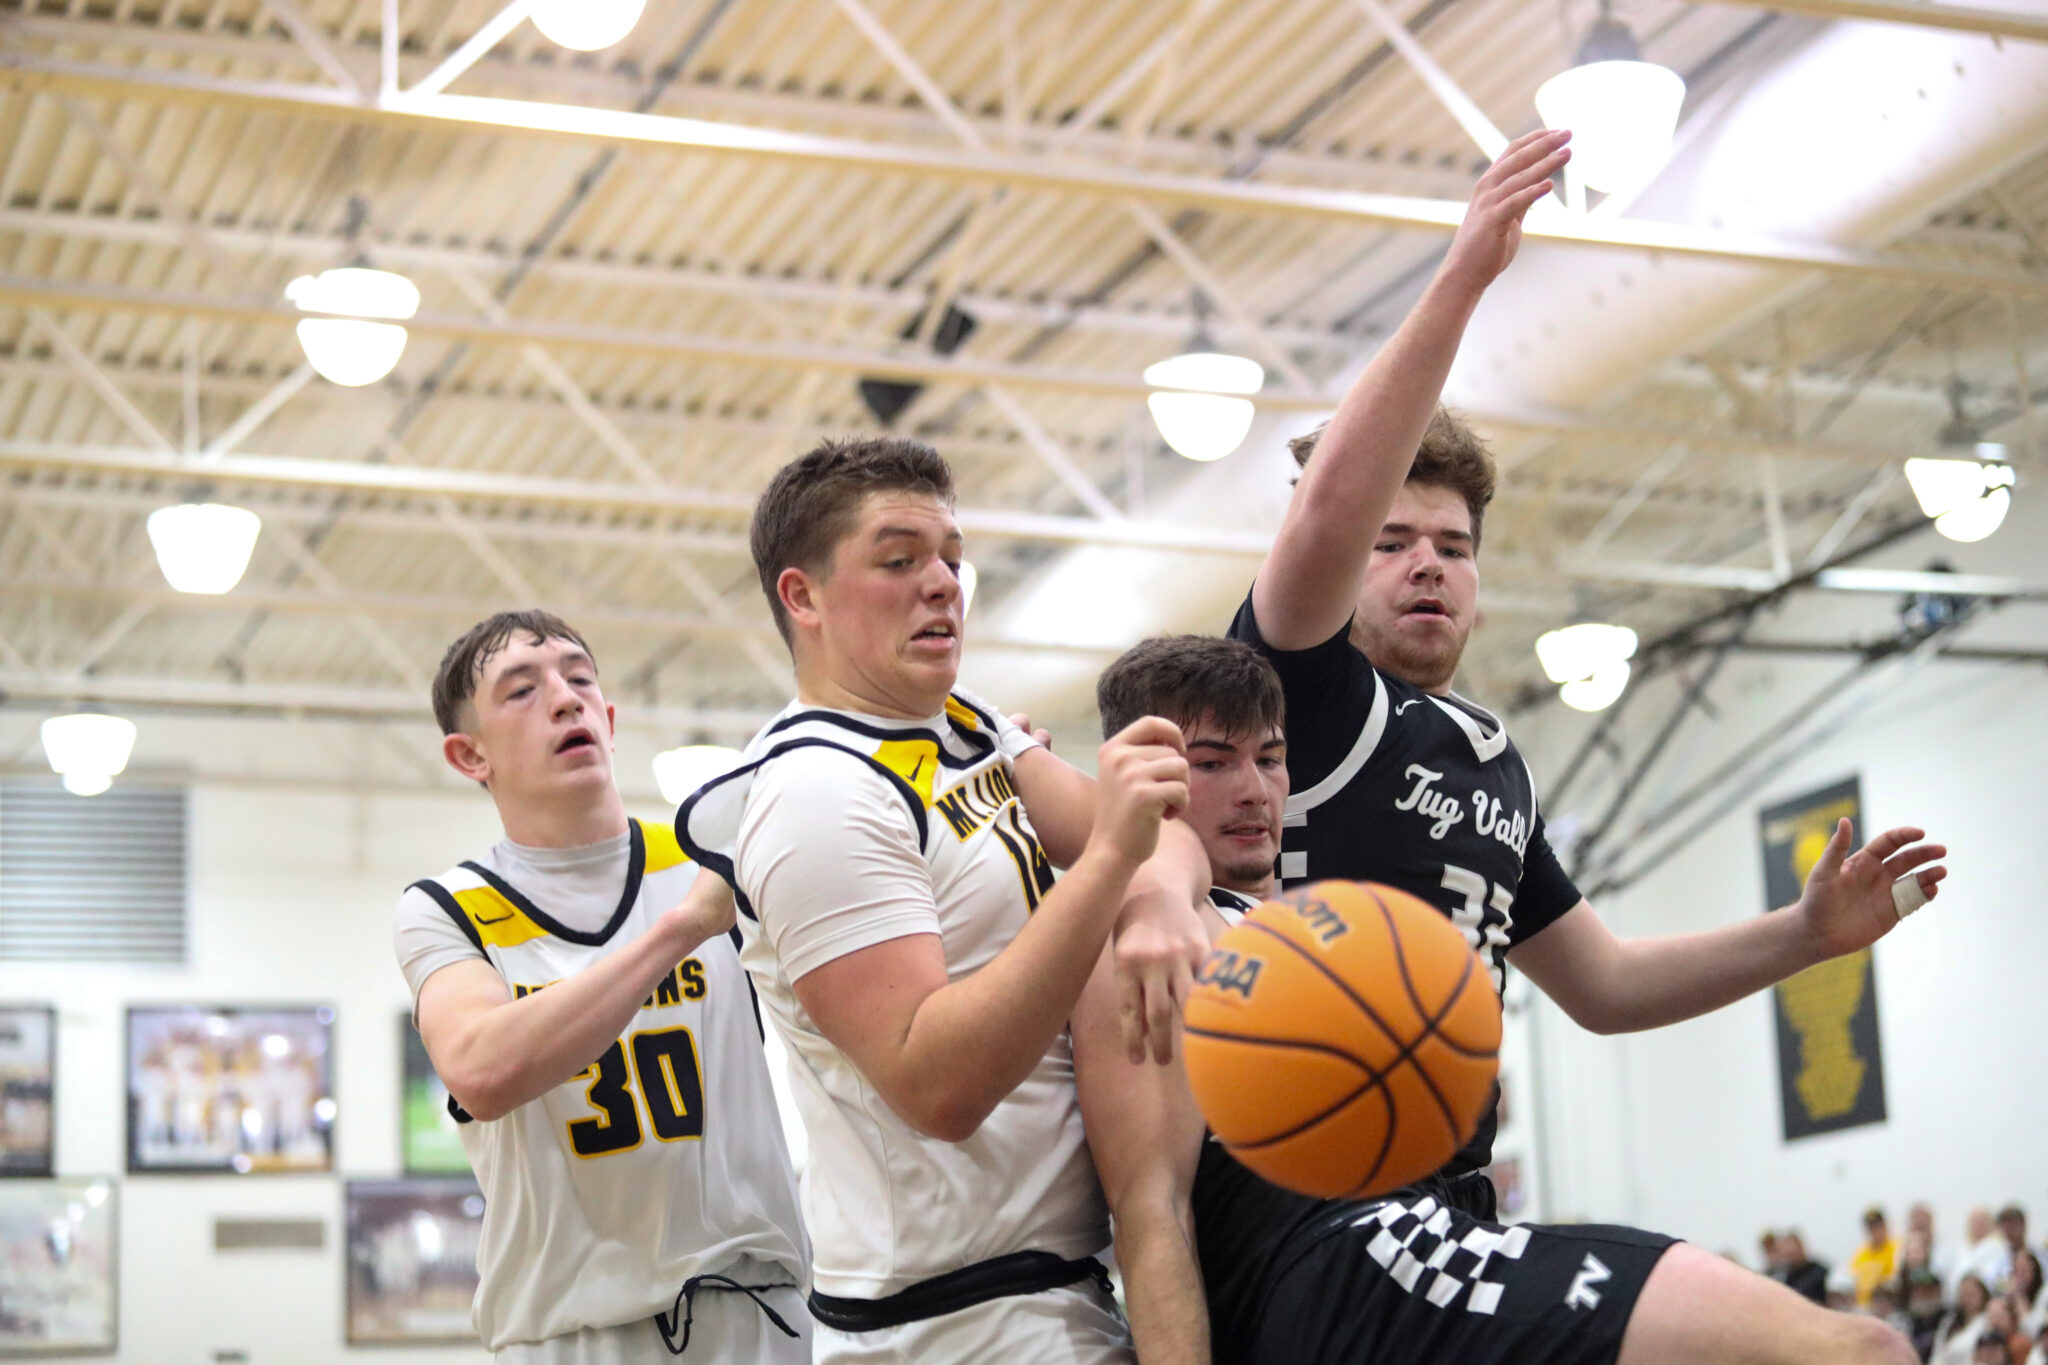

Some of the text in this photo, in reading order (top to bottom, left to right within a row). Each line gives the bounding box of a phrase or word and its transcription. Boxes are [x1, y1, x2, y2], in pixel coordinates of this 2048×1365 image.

[1394, 763, 1527, 861] Tug Vall
[564, 1023, 707, 1161] 30
